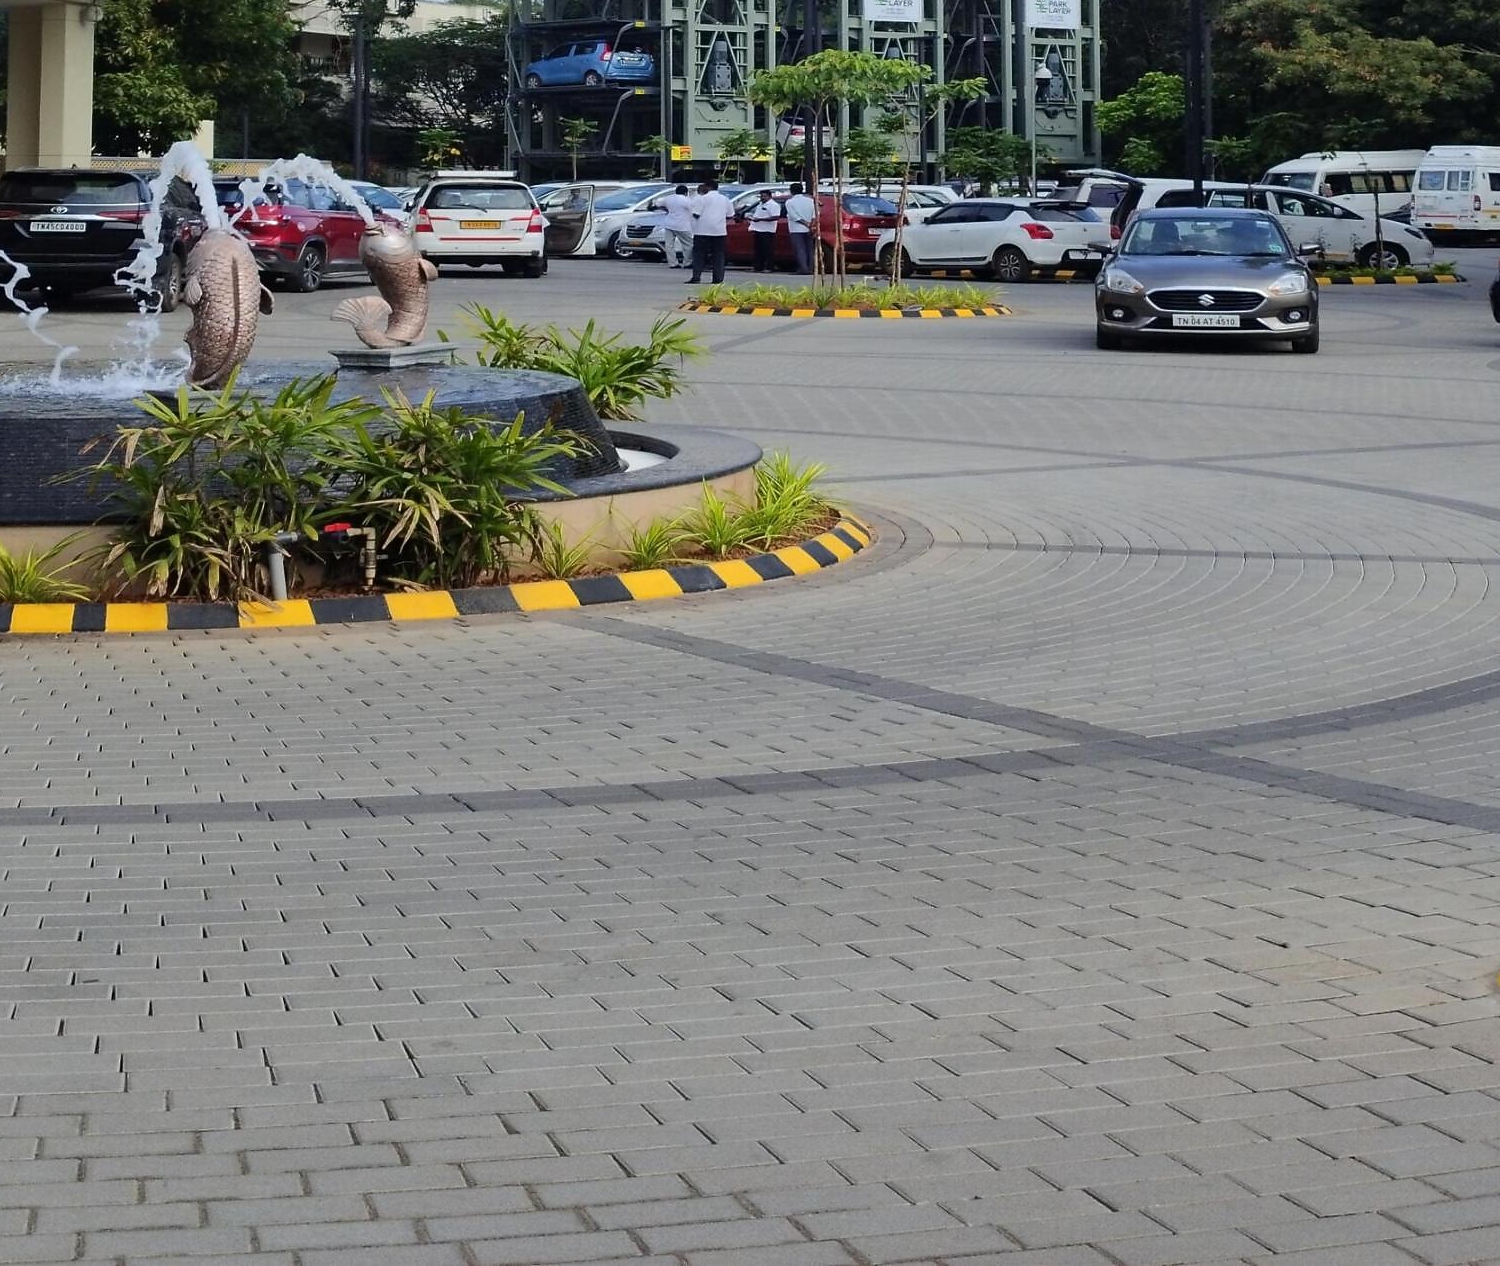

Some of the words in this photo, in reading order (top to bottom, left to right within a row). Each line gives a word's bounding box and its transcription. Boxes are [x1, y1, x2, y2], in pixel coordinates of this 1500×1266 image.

[888, 0, 913, 7] LAYER
[1048, 7, 1071, 15] LAYER
[1177, 317, 1189, 326] TN
